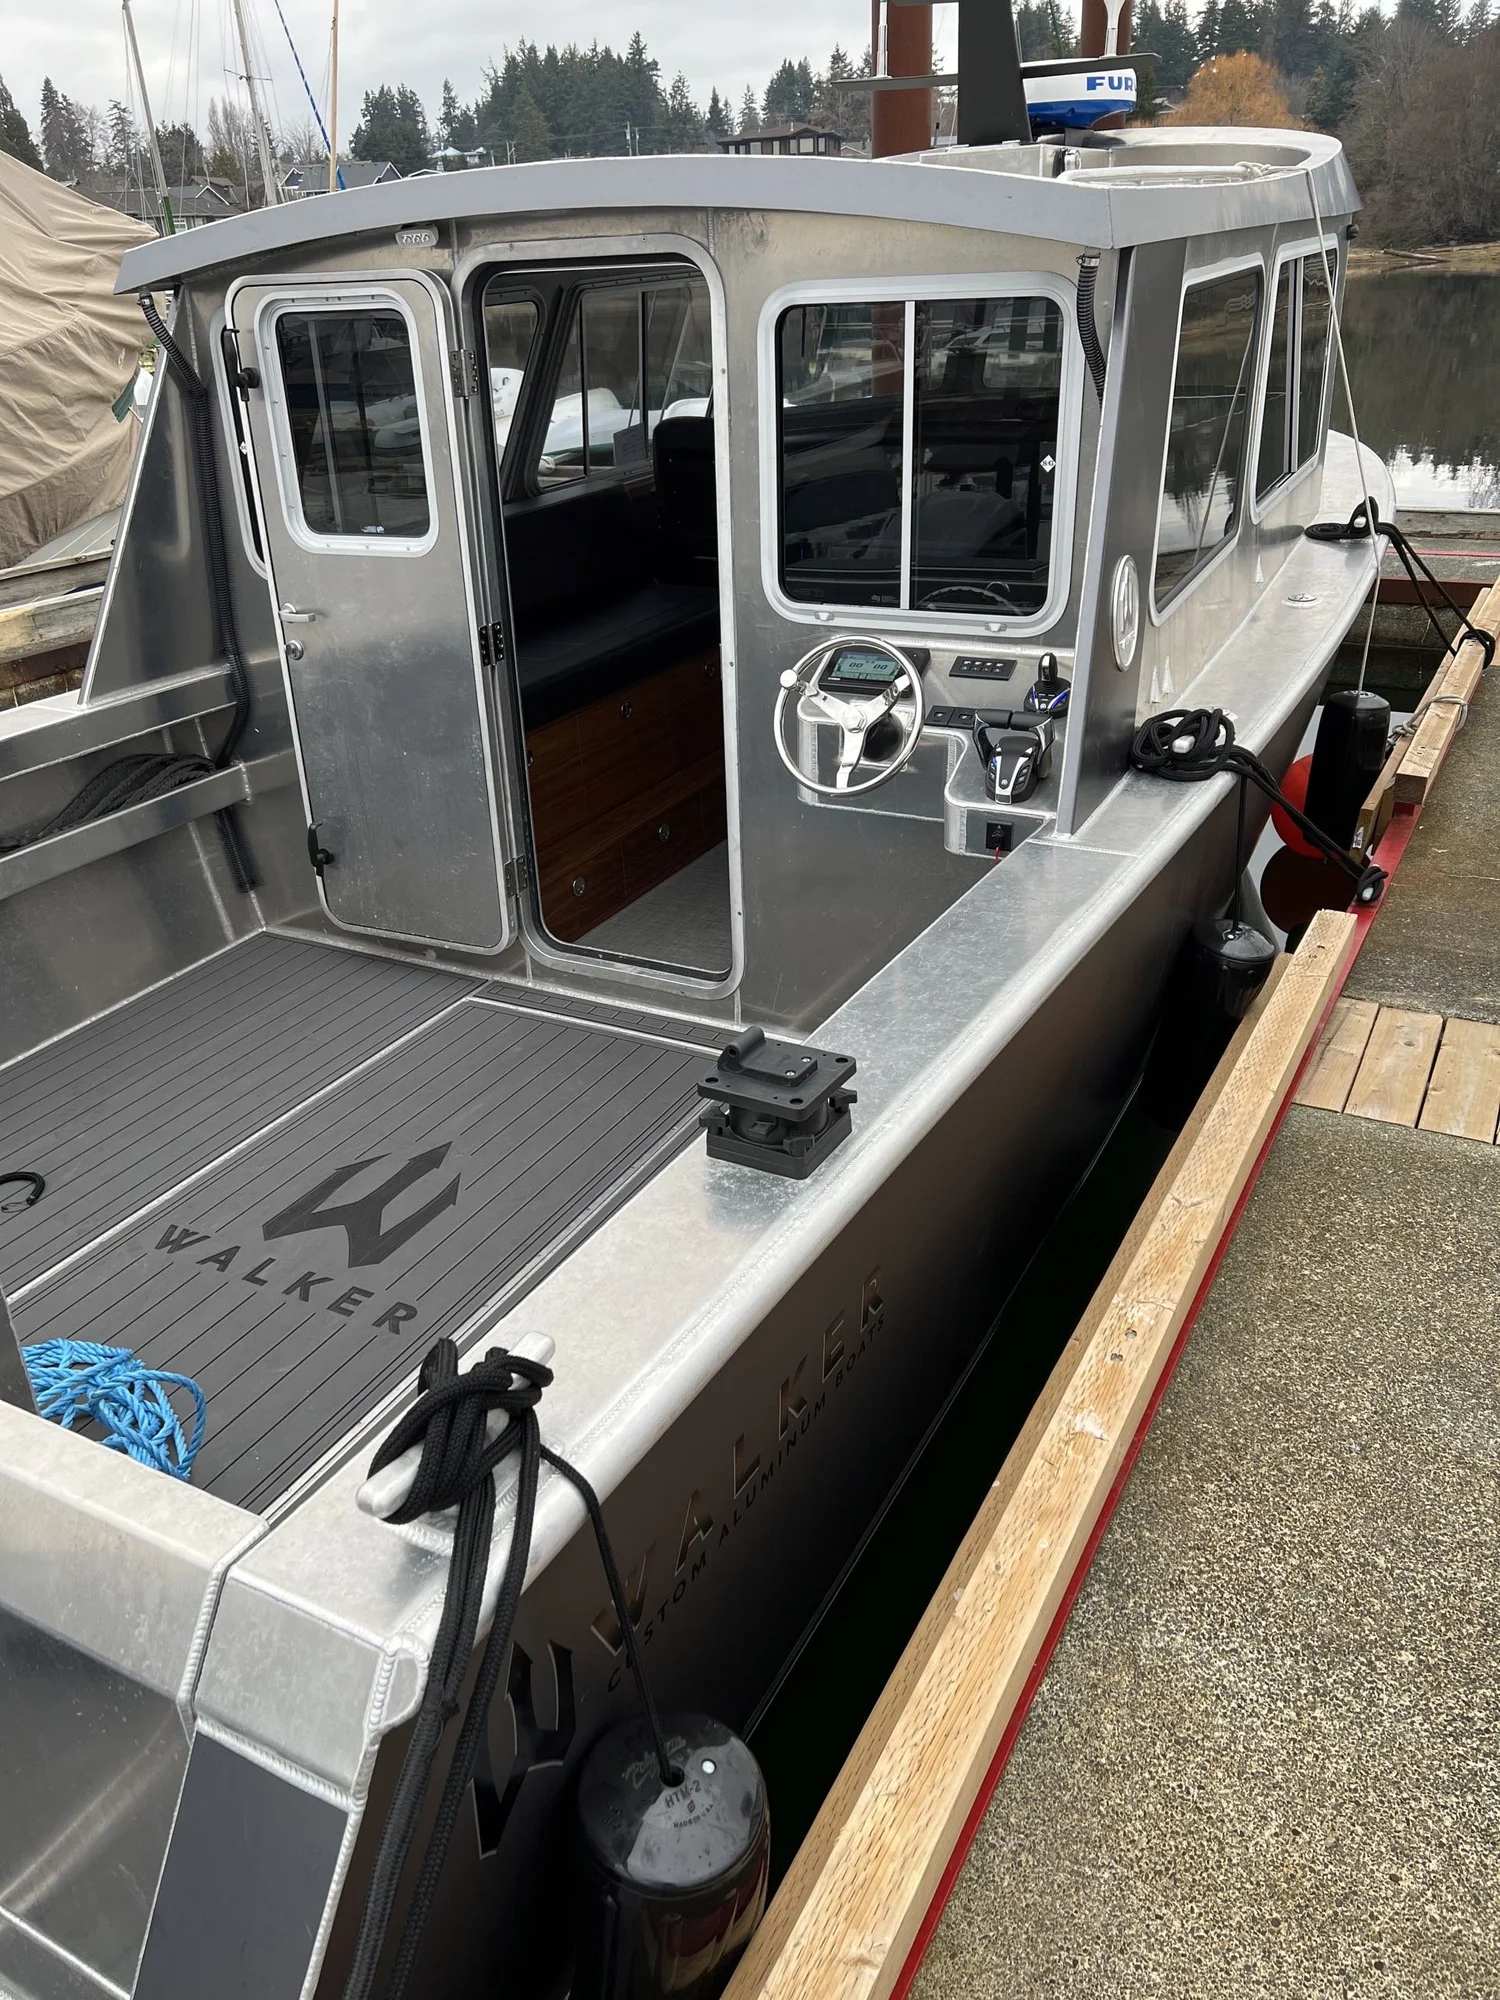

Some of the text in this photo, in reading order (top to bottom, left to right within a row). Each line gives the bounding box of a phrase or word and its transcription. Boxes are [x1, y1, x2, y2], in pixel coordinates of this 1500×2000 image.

[1086, 76, 1137, 92] FUR
[154, 1224, 418, 1335] WALKER
[590, 1264, 884, 1656] WALKER
[718, 1392, 826, 1546] ALUMINUM
[836, 1313, 884, 1388] BOATS
